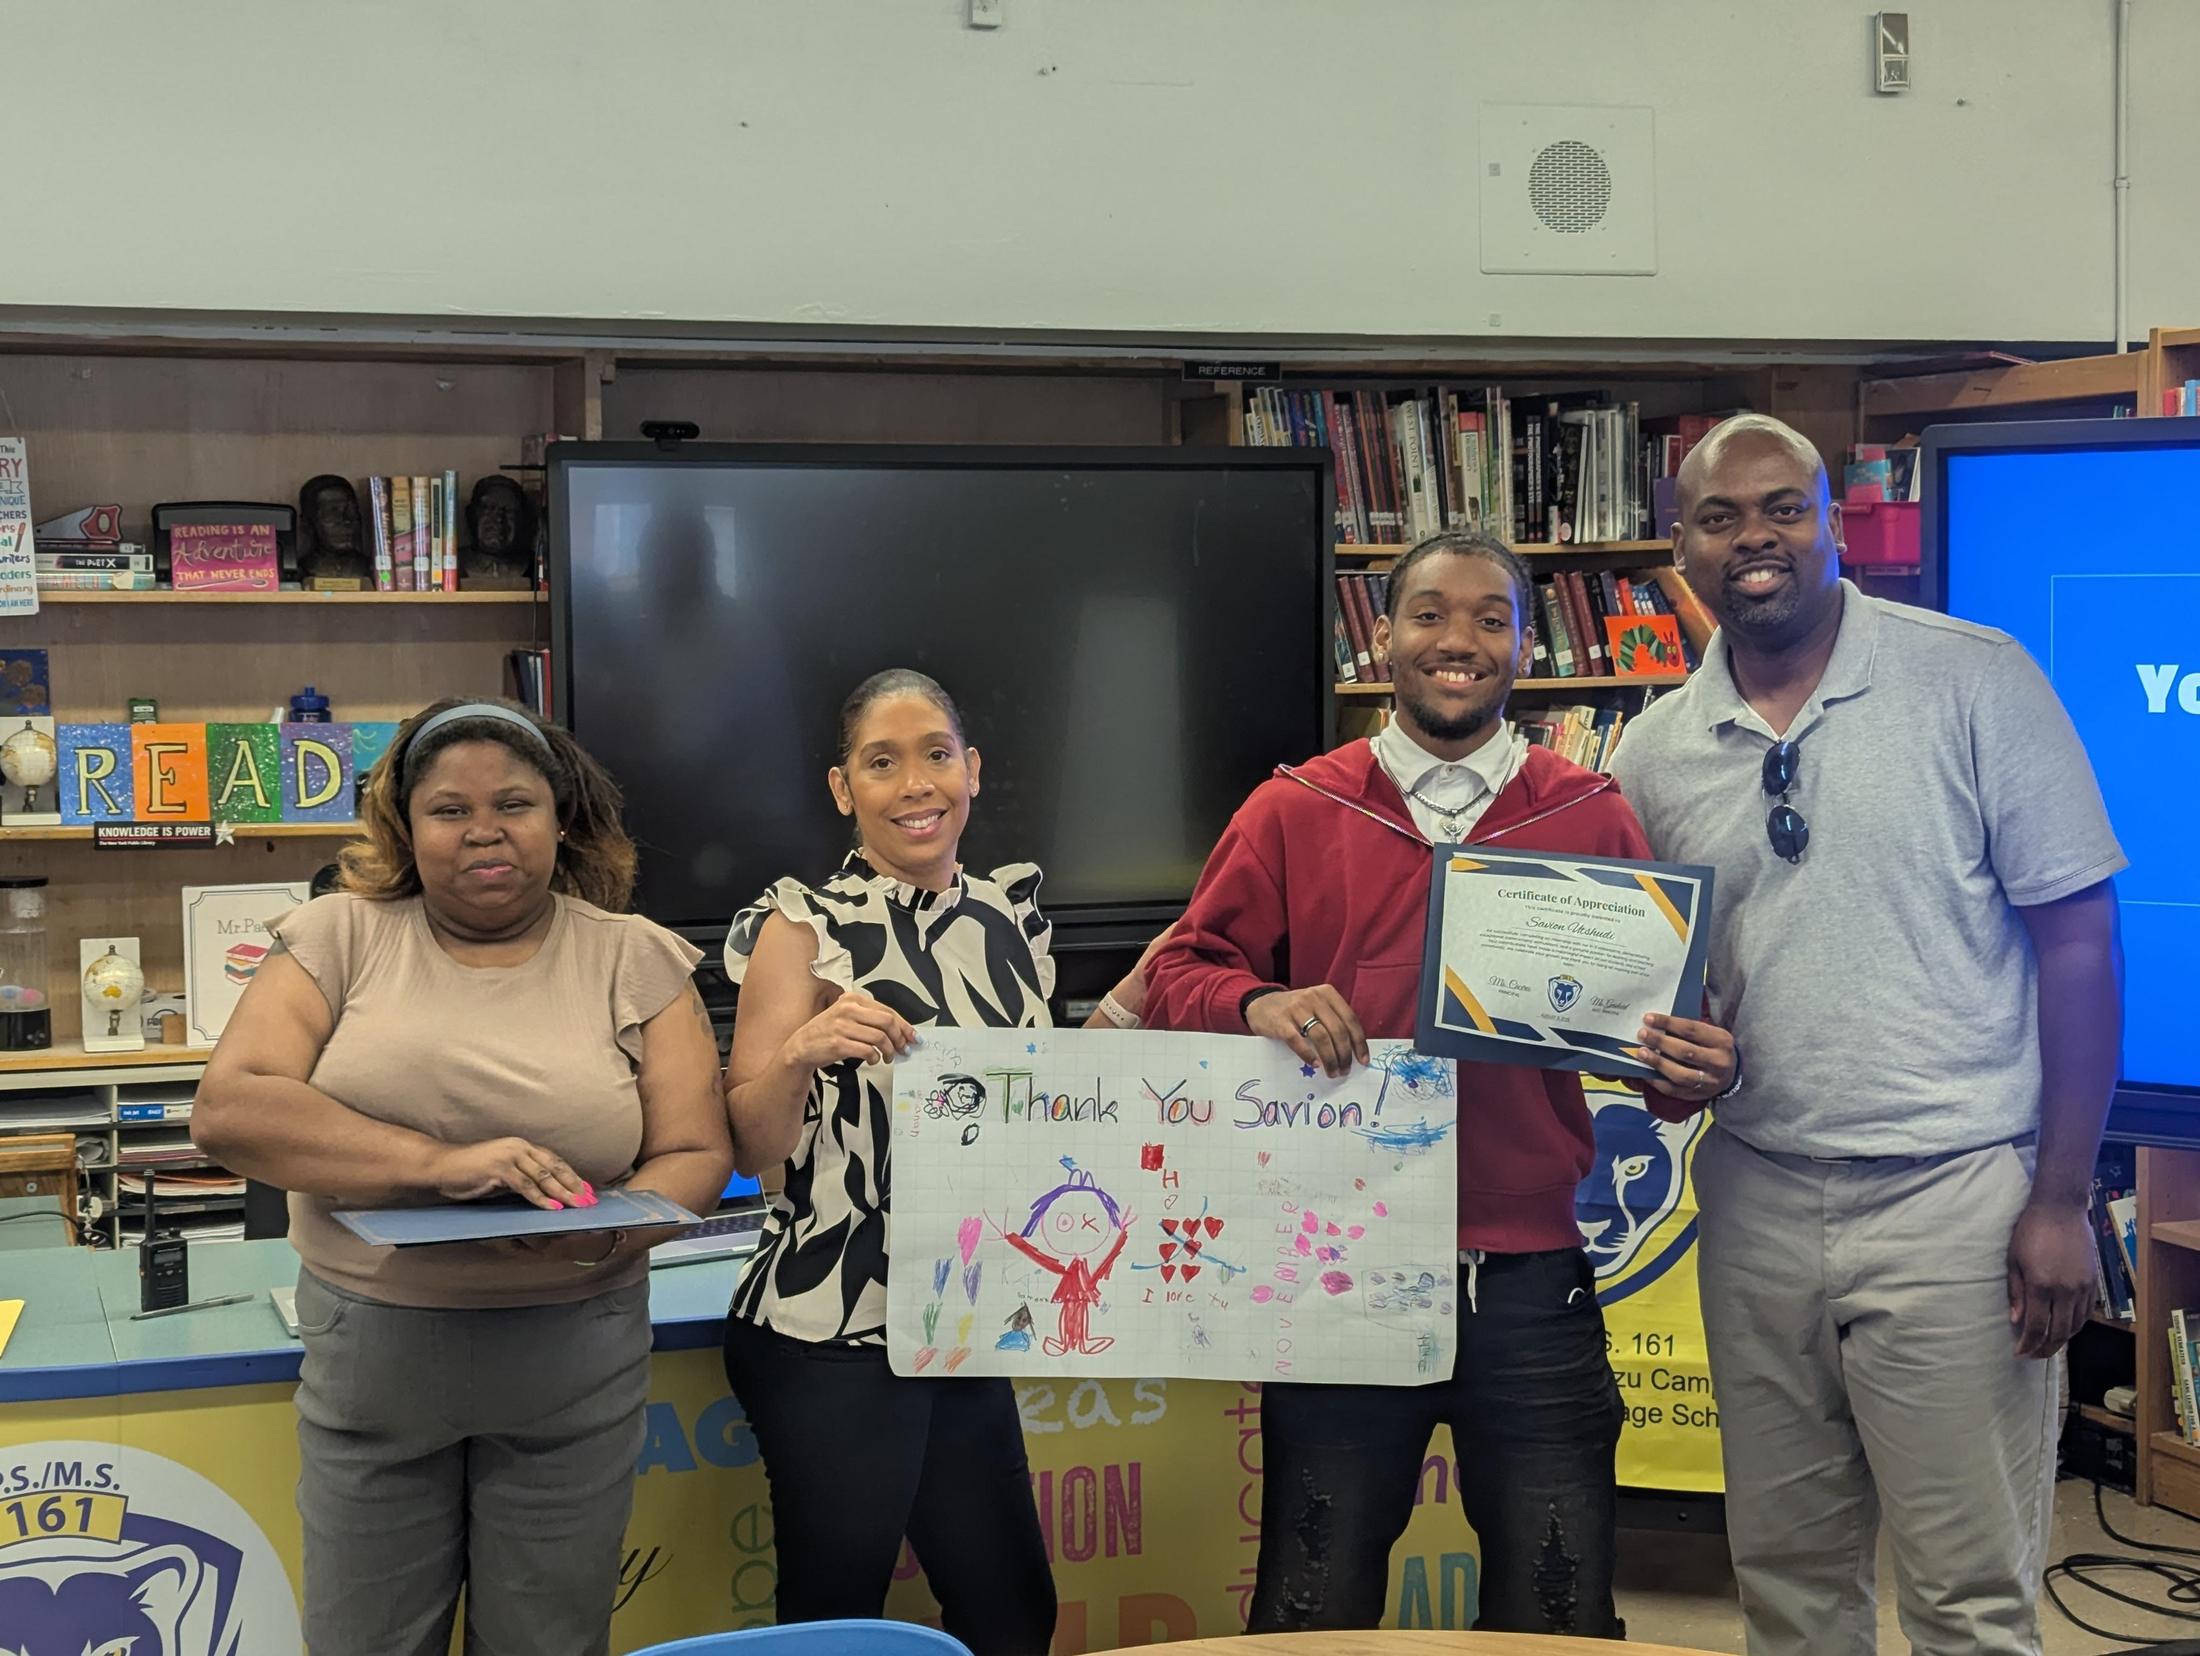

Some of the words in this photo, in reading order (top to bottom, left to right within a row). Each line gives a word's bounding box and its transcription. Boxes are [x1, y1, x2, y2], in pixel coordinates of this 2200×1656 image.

[1198, 365, 1266, 376] REFERENCE
[1408, 435, 1420, 471] POINT
[174, 524, 229, 539] READING
[232, 525, 244, 536] IS
[251, 525, 269, 536] AN
[173, 538, 272, 566] Adventure
[176, 570, 205, 581] THAT
[210, 568, 246, 581] NEVER
[249, 567, 275, 580] ENDS
[74, 739, 343, 815] READ
[98, 826, 160, 838] KNOWLEDGE
[162, 826, 173, 837] IS
[175, 826, 211, 836] POWER
[1497, 888, 1558, 905] Certificate
[1560, 895, 1573, 905] of
[1573, 896, 1646, 918] Appreciation
[1525, 916, 1565, 931] Savion
[985, 1070, 1119, 1124] Thank
[1141, 1077, 1213, 1125] You
[1632, 1332, 1674, 1357] 161
[1651, 1368, 1716, 1400] Cam
[6, 1496, 93, 1537] 161
